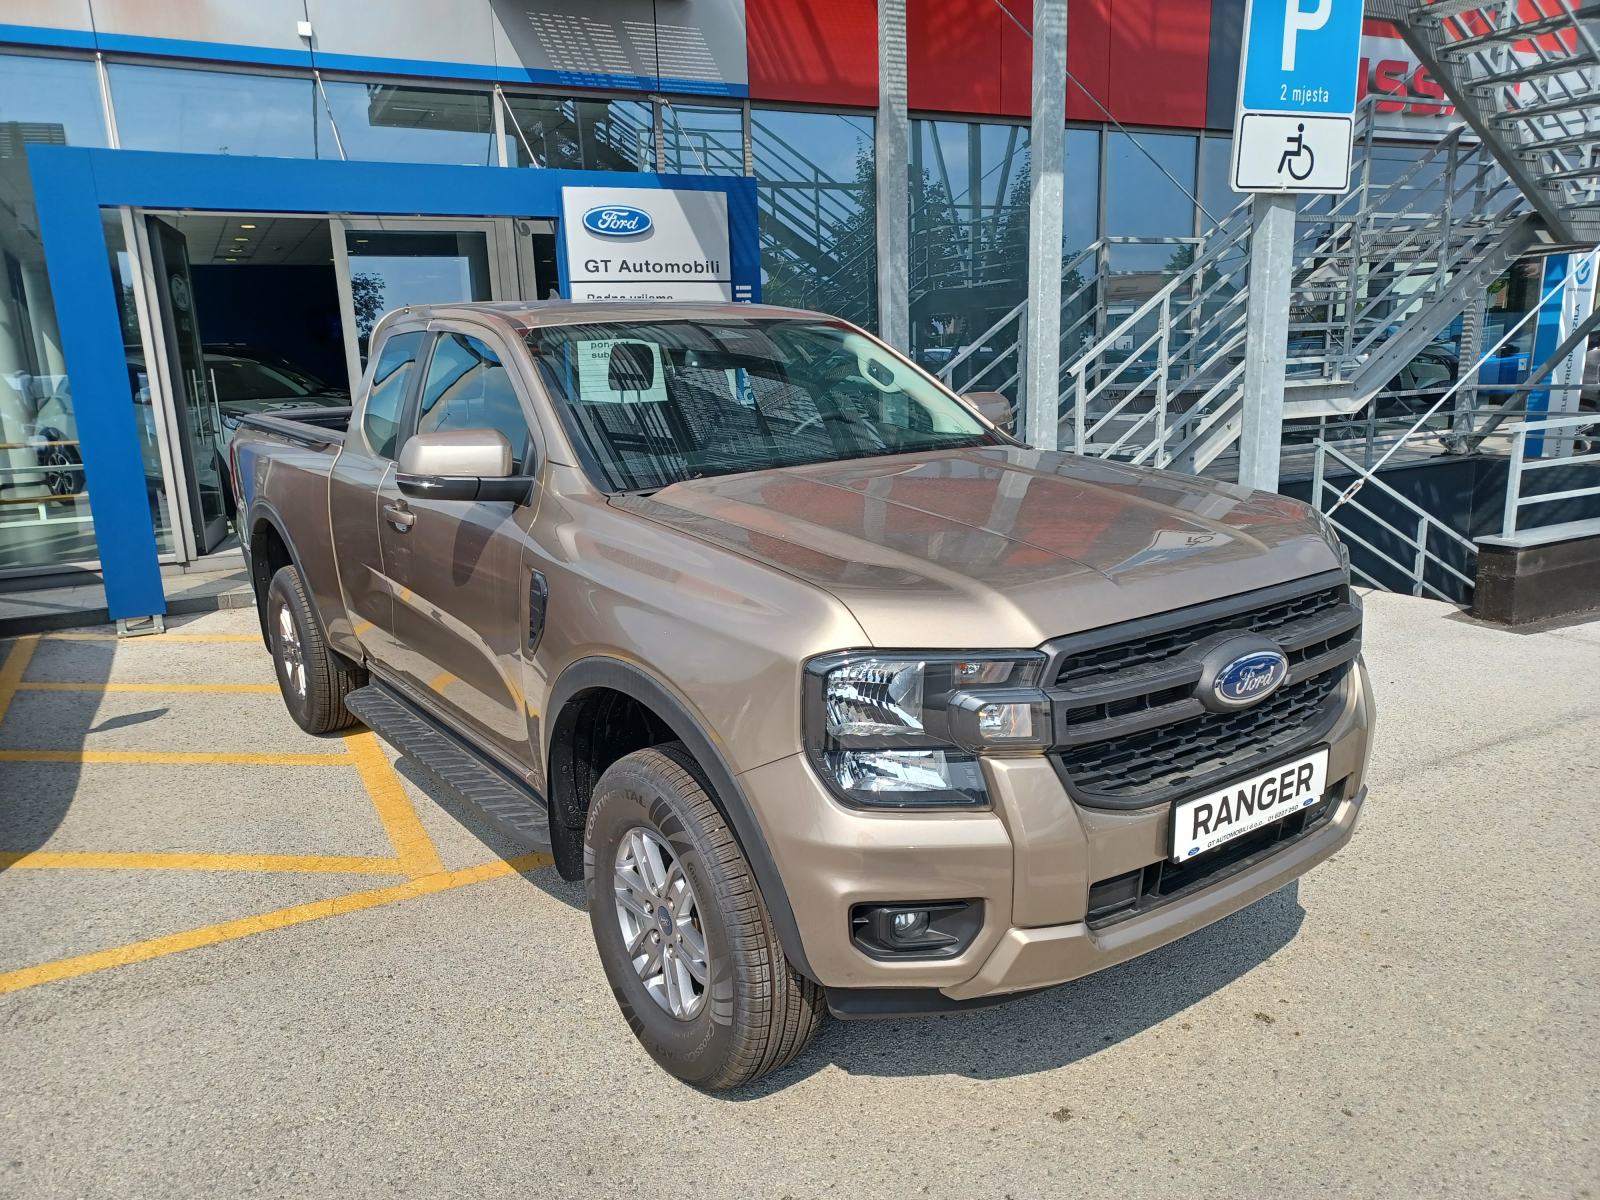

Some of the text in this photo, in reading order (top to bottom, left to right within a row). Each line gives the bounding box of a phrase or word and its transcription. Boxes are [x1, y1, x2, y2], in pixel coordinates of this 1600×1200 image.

[1281, 0, 1332, 71] P
[1280, 83, 1329, 106] 2 mjesta
[597, 210, 639, 229] Ford
[584, 259, 720, 274] GT Automobili
[1235, 663, 1275, 695] Ford
[1192, 762, 1314, 841] RANGER
